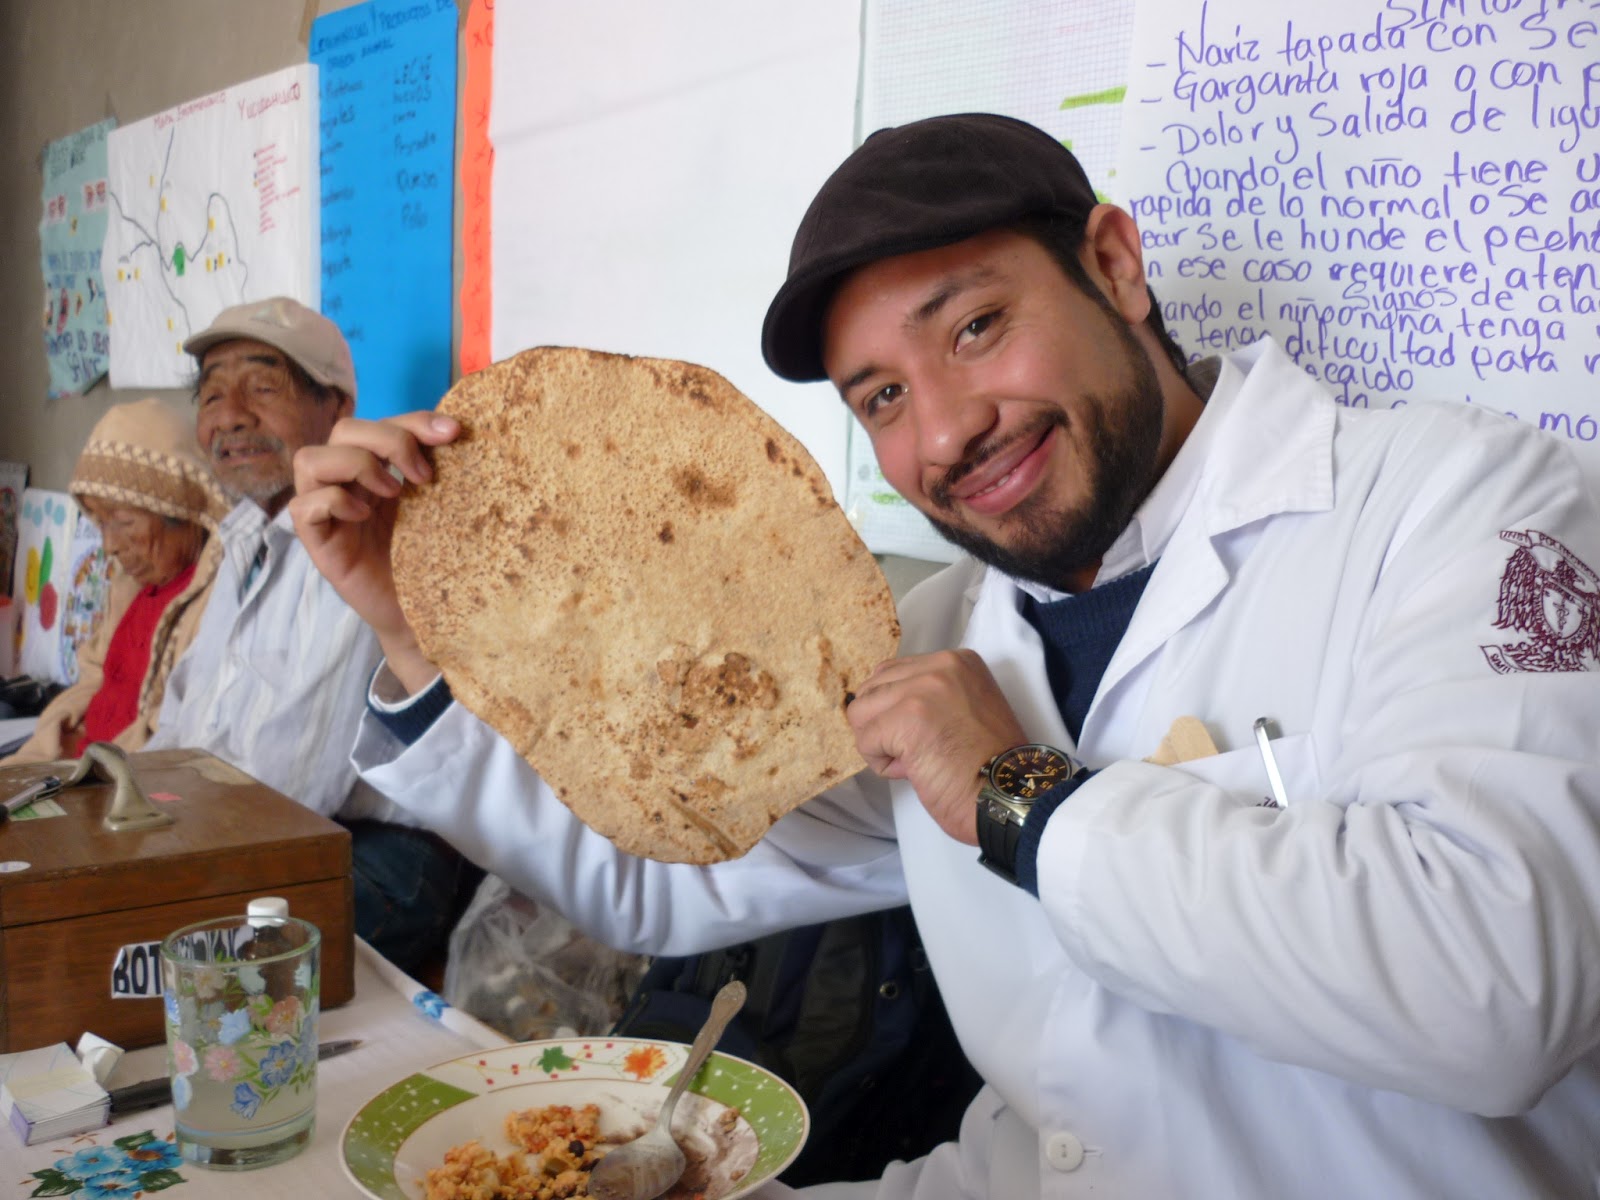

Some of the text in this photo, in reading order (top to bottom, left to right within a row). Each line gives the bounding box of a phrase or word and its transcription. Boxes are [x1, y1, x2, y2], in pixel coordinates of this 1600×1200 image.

[1175, 0, 1260, 72] Nariz
[1277, 12, 1405, 69] tapada
[1174, 61, 1339, 114] Garganta
[1360, 63, 1427, 107] roja
[1454, 64, 1476, 92] o
[1162, 110, 1264, 155] Dolor
[1275, 115, 1299, 164] y
[1450, 89, 1506, 134] de
[1166, 156, 1279, 193] Cuando
[1293, 151, 1327, 191] el
[1345, 158, 1421, 189] niño
[1444, 151, 1548, 188] tiene
[1129, 184, 1211, 224] rapida
[1226, 182, 1266, 218] de
[1279, 182, 1304, 218] lo
[1321, 184, 1450, 220] normal
[1469, 194, 1490, 215] o
[1254, 218, 1283, 251] le
[1300, 217, 1406, 252] hunde
[1425, 220, 1471, 253] el
[1177, 256, 1227, 281] ese
[1243, 258, 1312, 282] caso
[1329, 261, 1478, 293] requiere
[1471, 277, 1515, 312] de
[1538, 277, 1600, 314] ala
[1238, 288, 1265, 322] el
[1456, 308, 1566, 358] tenga
[1285, 318, 1456, 368] dificultad
[1471, 344, 1559, 381] para
